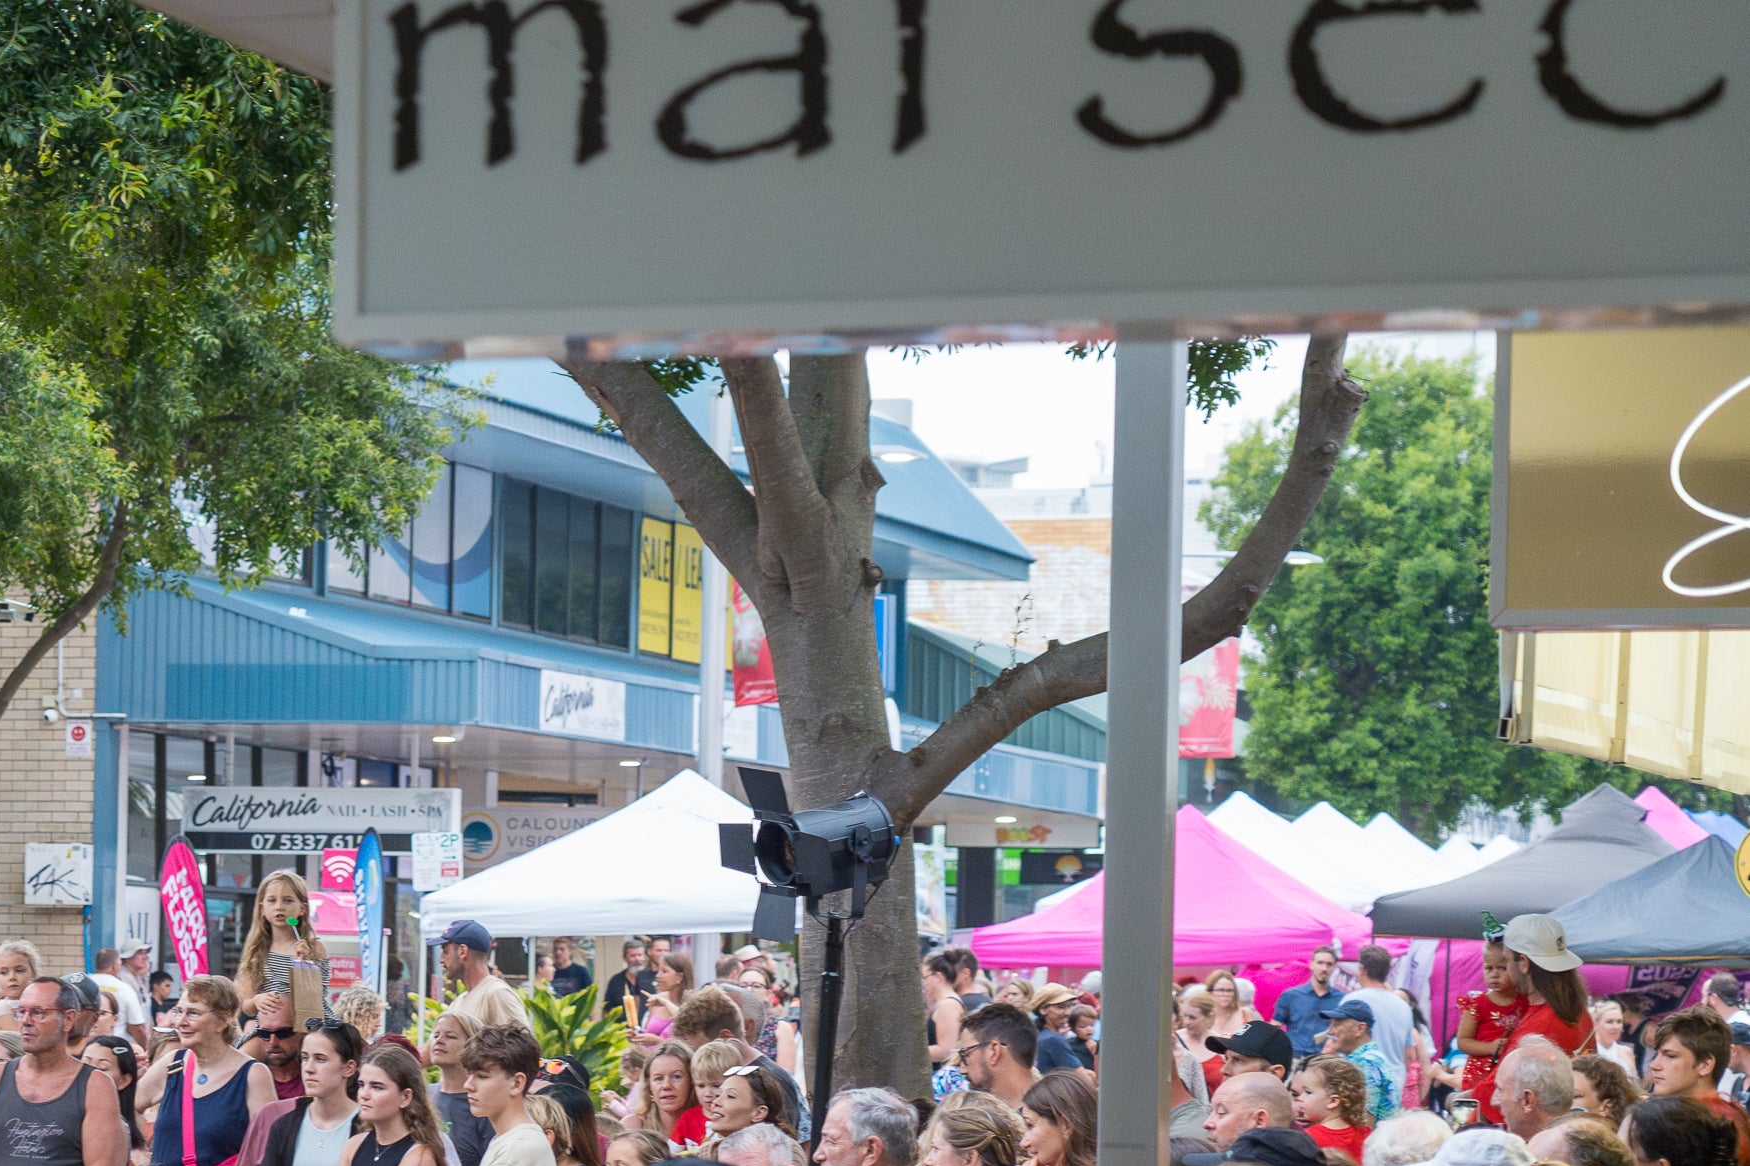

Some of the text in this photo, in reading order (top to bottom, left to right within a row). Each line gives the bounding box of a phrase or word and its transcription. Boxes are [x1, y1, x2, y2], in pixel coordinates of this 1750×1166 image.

[192, 793, 444, 831] California NAIL LASH SPA
[506, 817, 596, 831] CALOUN
[251, 833, 363, 850] 07 5337 61
[440, 834, 459, 848] 2P
[507, 836, 556, 848] VISI
[176, 868, 207, 951] FAIRY
[127, 912, 152, 944] AIL
[162, 875, 198, 979] FLOSS
